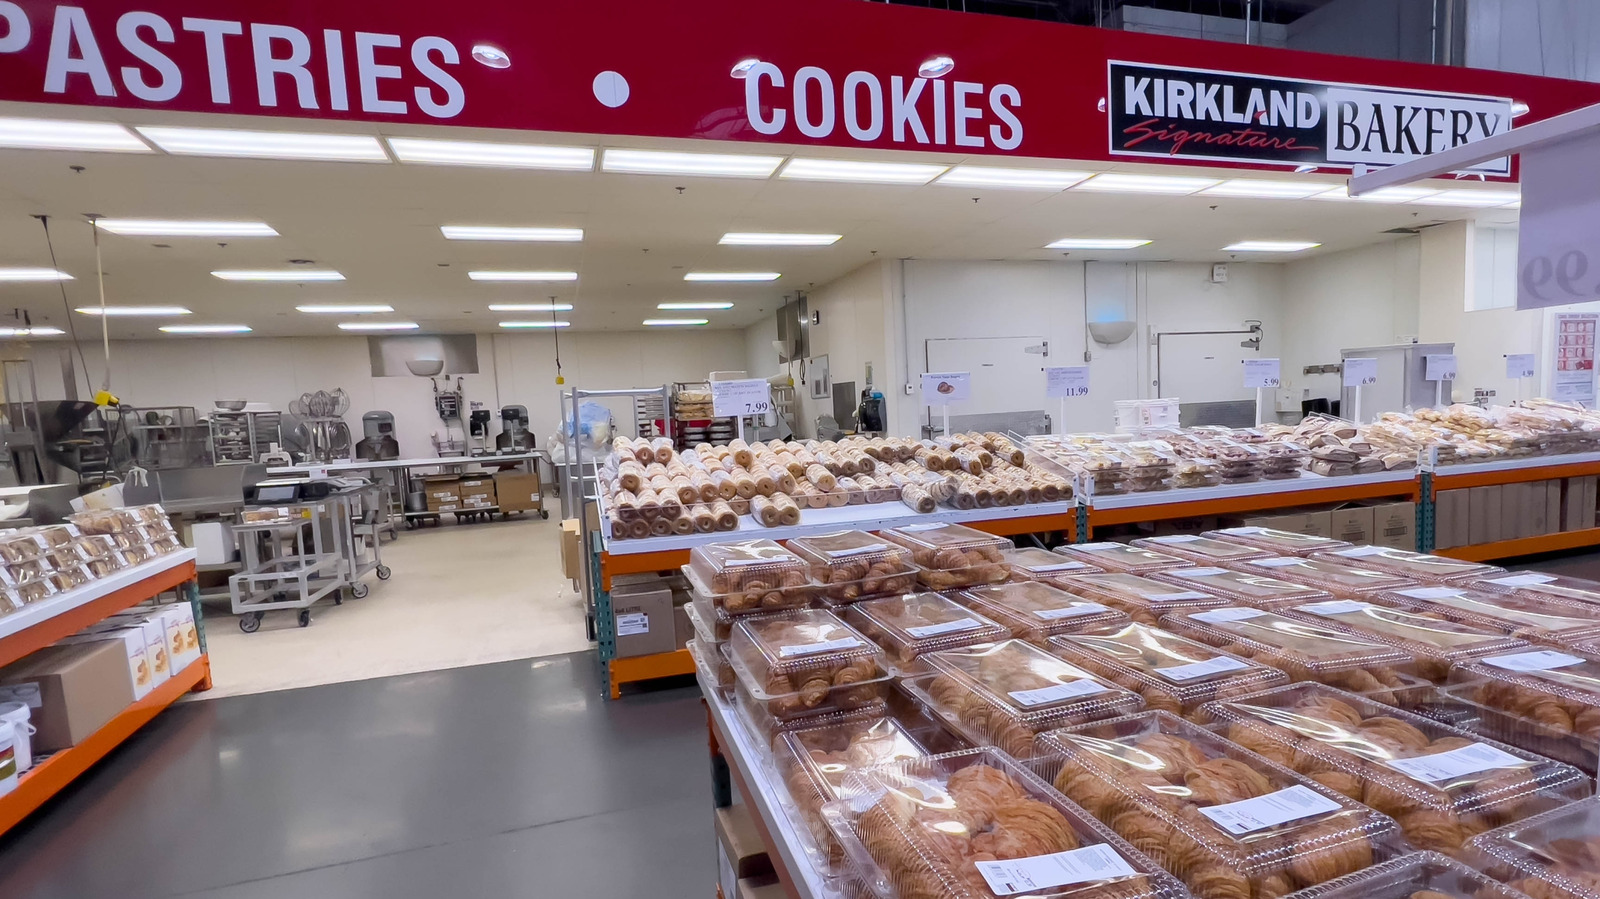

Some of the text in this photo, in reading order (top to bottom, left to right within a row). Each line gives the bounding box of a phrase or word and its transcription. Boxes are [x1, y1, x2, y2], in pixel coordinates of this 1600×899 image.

[745, 61, 1024, 150] COOKIES
[1124, 75, 1321, 129] KIRKLAND
[1123, 118, 1320, 156] Signature
[1263, 378, 1280, 387] 5.99
[1362, 376, 1377, 385] 6.99
[1066, 386, 1089, 397] 11.99
[745, 402, 768, 413] 7.99
